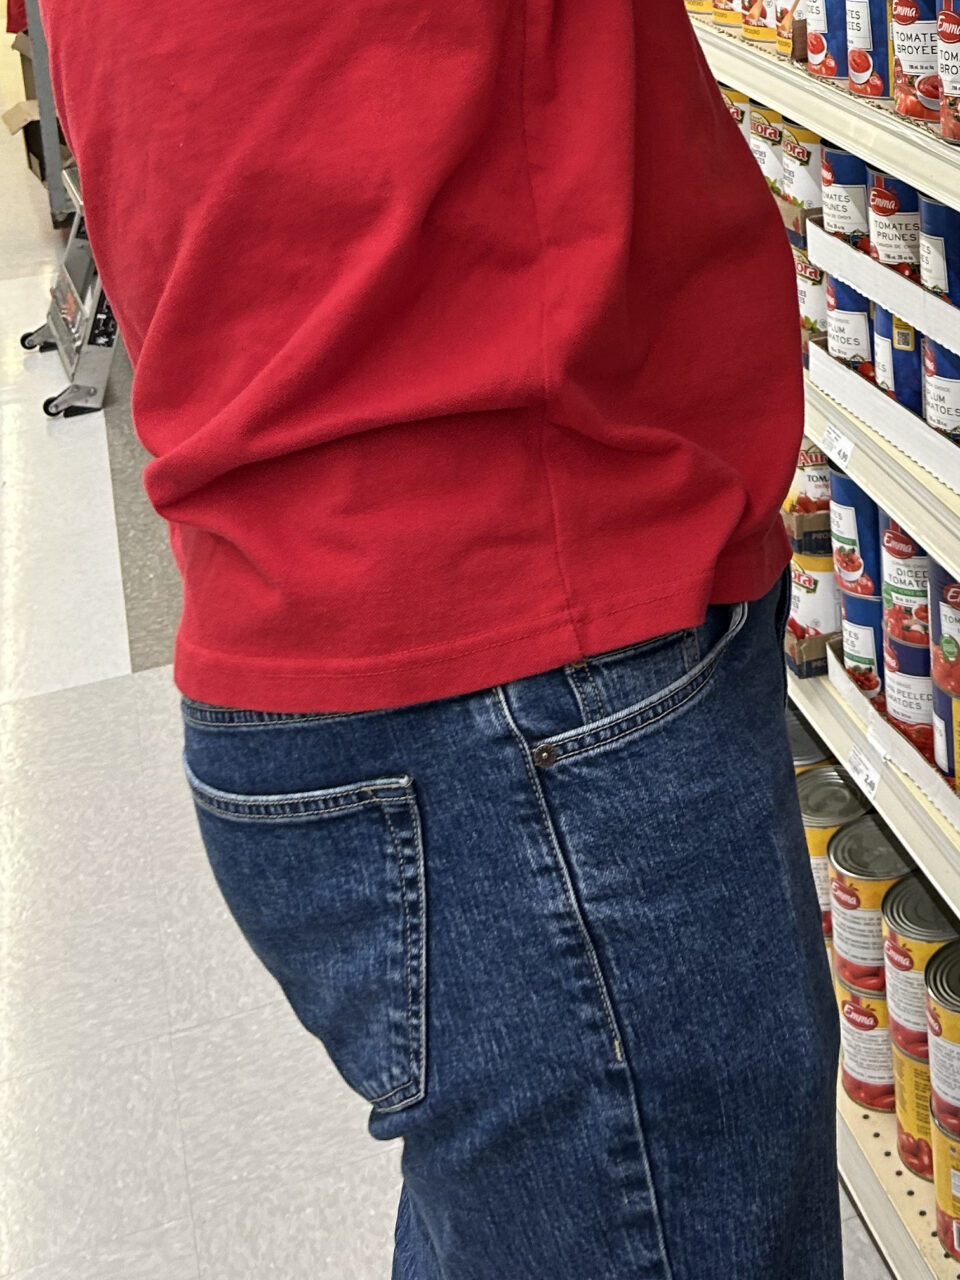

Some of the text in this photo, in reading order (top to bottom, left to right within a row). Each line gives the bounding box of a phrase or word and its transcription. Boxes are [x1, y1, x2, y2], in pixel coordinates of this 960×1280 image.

[892, 5, 917, 17] Emma
[870, 191, 896, 210] Emma
[874, 220, 920, 232] TOMATES
[877, 231, 917, 241] PRUNES
[883, 531, 913, 555] Emma
[831, 880, 858, 905] Emma
[883, 940, 911, 966] Emma
[843, 1006, 876, 1026] Emma
